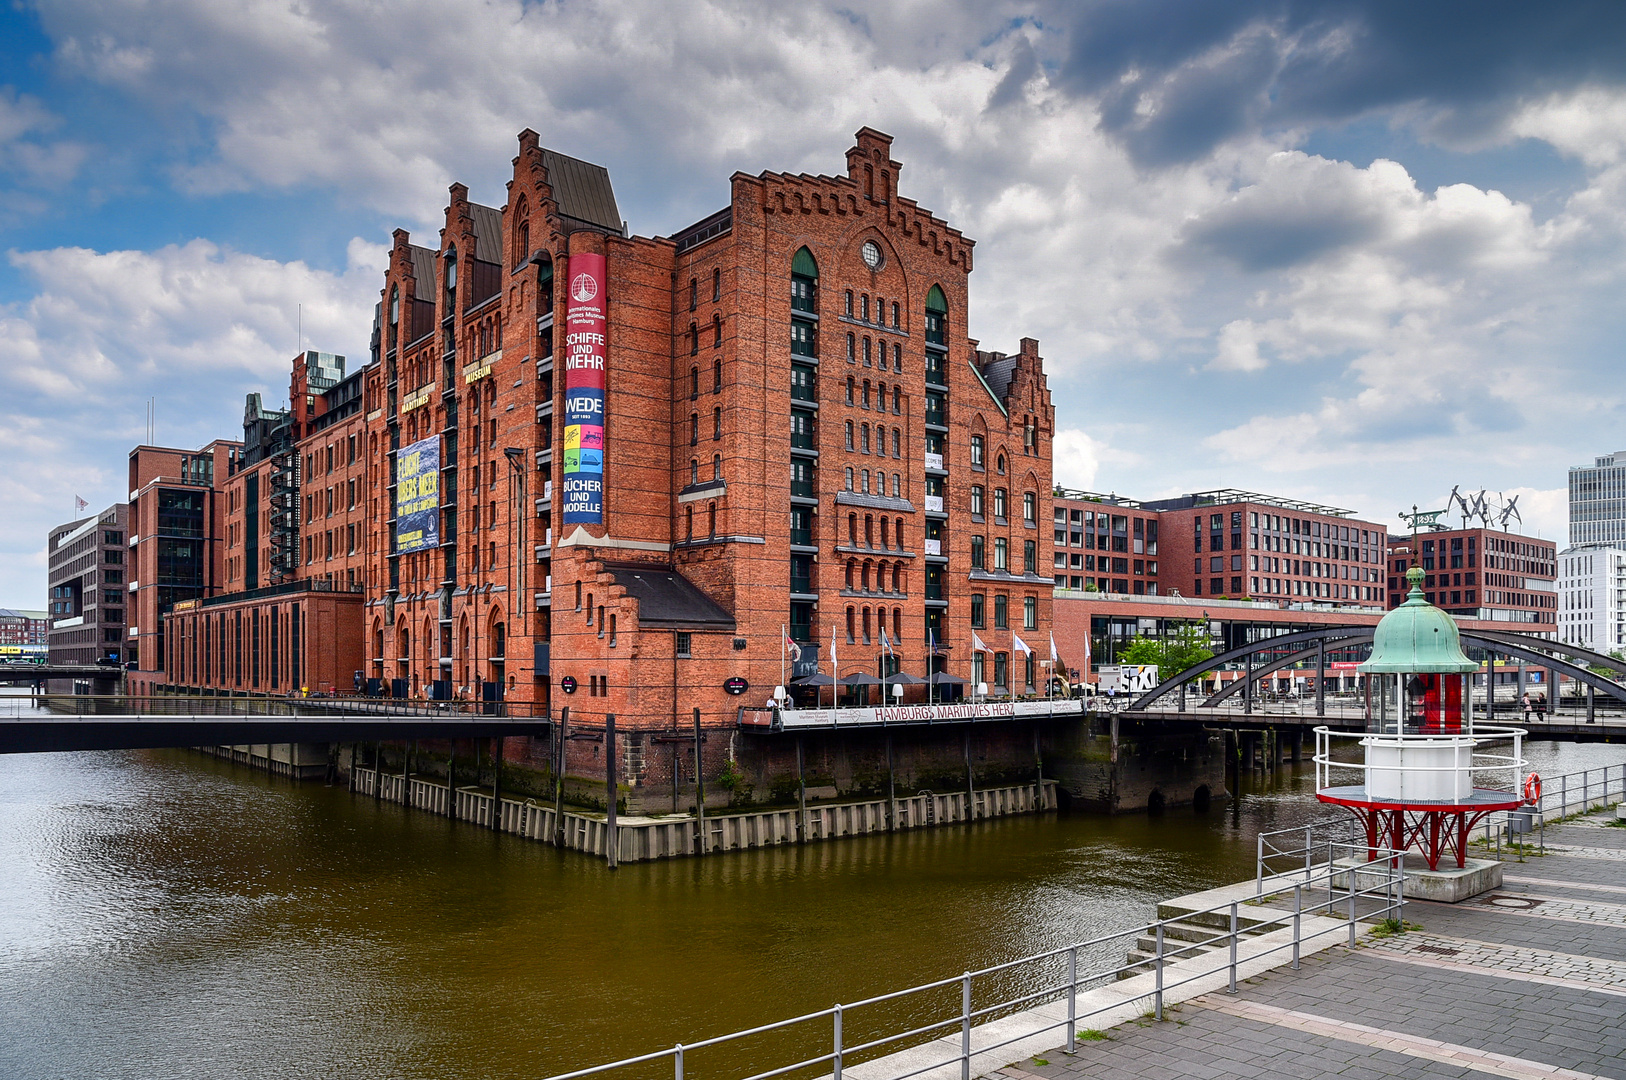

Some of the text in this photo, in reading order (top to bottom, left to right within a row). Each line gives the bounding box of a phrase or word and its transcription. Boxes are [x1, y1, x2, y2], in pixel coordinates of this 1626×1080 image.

[585, 311, 605, 320] Museum
[566, 332, 604, 346] SCHIFFE
[573, 345, 593, 354] UND
[566, 354, 604, 370] MEHR
[465, 364, 491, 385] MUSEUM
[401, 393, 429, 414] MARITIMES
[565, 397, 602, 413] WEDE
[398, 451, 420, 479] FLUCHT
[419, 470, 437, 497] MEER
[563, 478, 601, 492] BÜCHER
[570, 492, 590, 502] UND
[563, 502, 600, 513] MODELLE
[875, 707, 934, 721] HAMBURGS
[937, 704, 990, 719] MARITIMES
[992, 703, 1014, 715] HERZ
